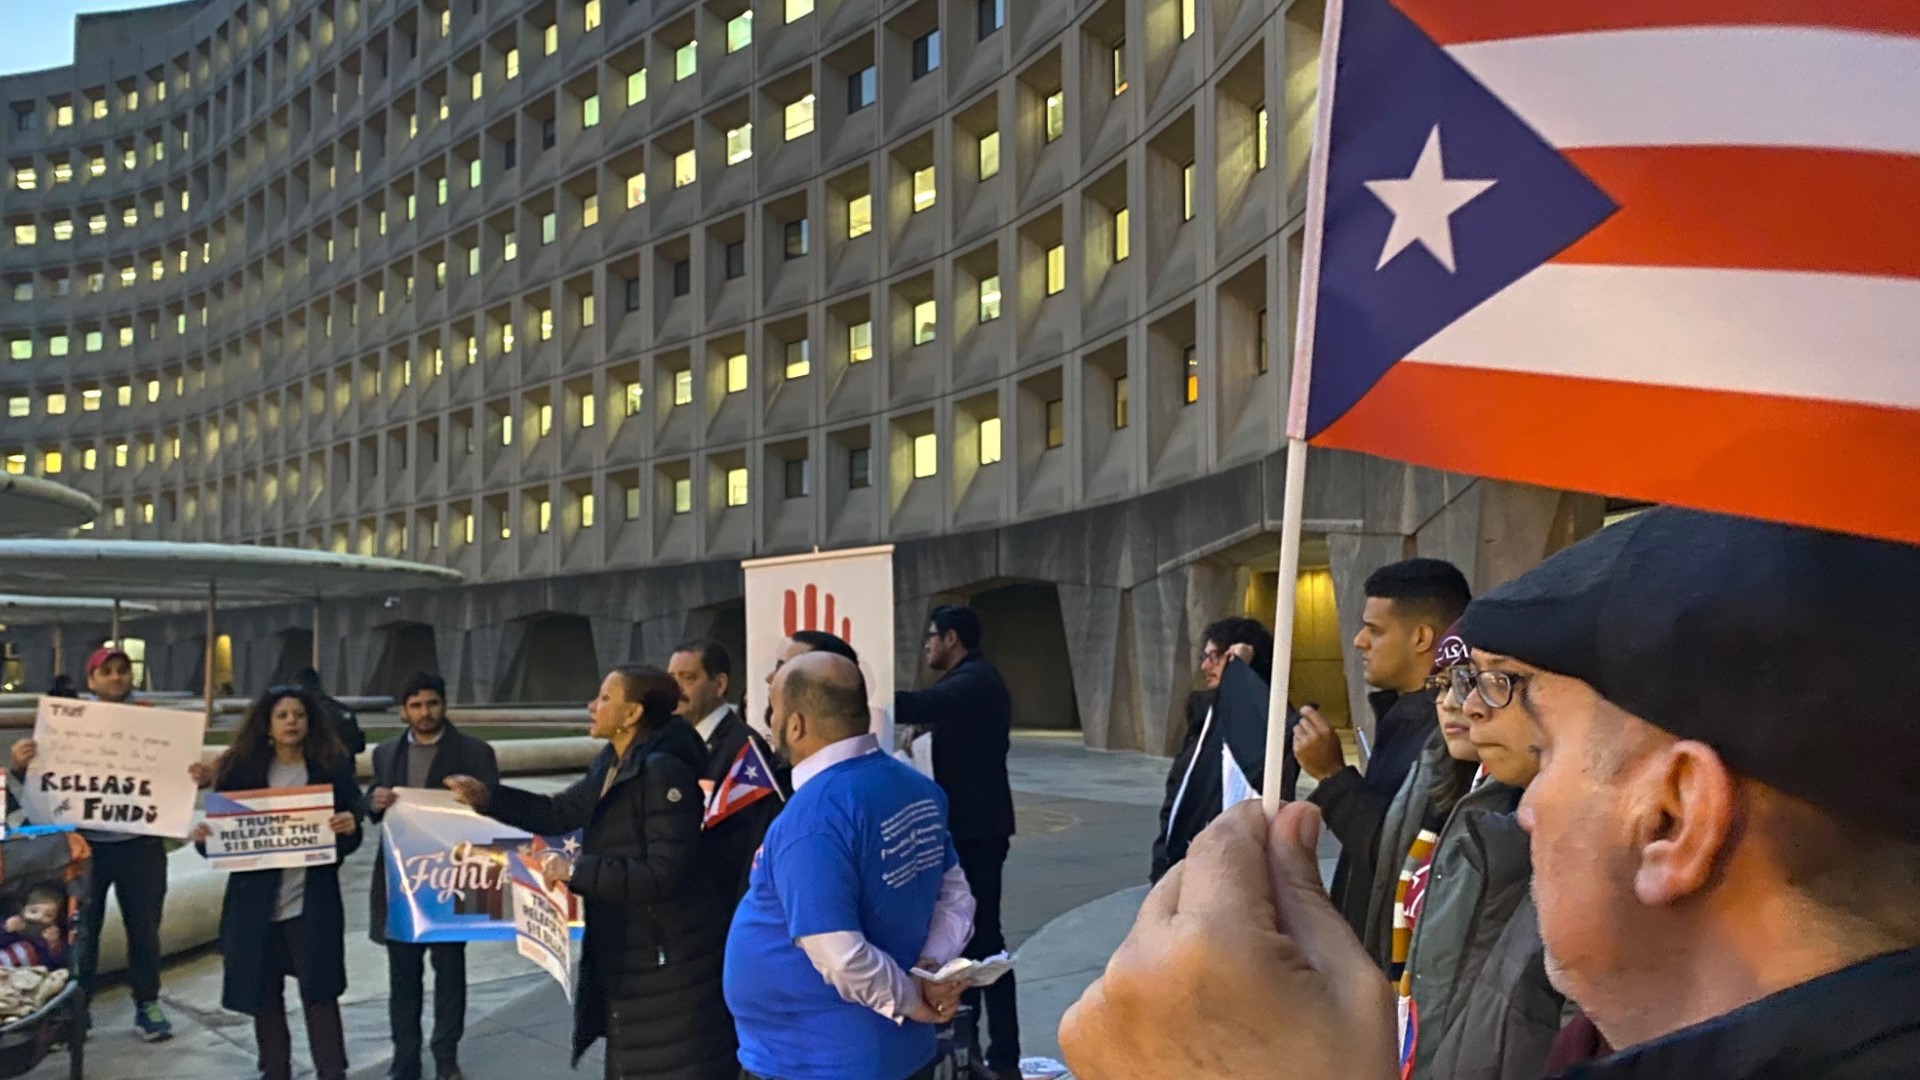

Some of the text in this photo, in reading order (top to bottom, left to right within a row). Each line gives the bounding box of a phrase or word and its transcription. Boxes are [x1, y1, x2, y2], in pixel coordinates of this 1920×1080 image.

[41, 772, 151, 796] RELEASE
[83, 797, 158, 824] FUNDS
[221, 823, 319, 840] RELEASE THE
[401, 840, 496, 904] Fight
